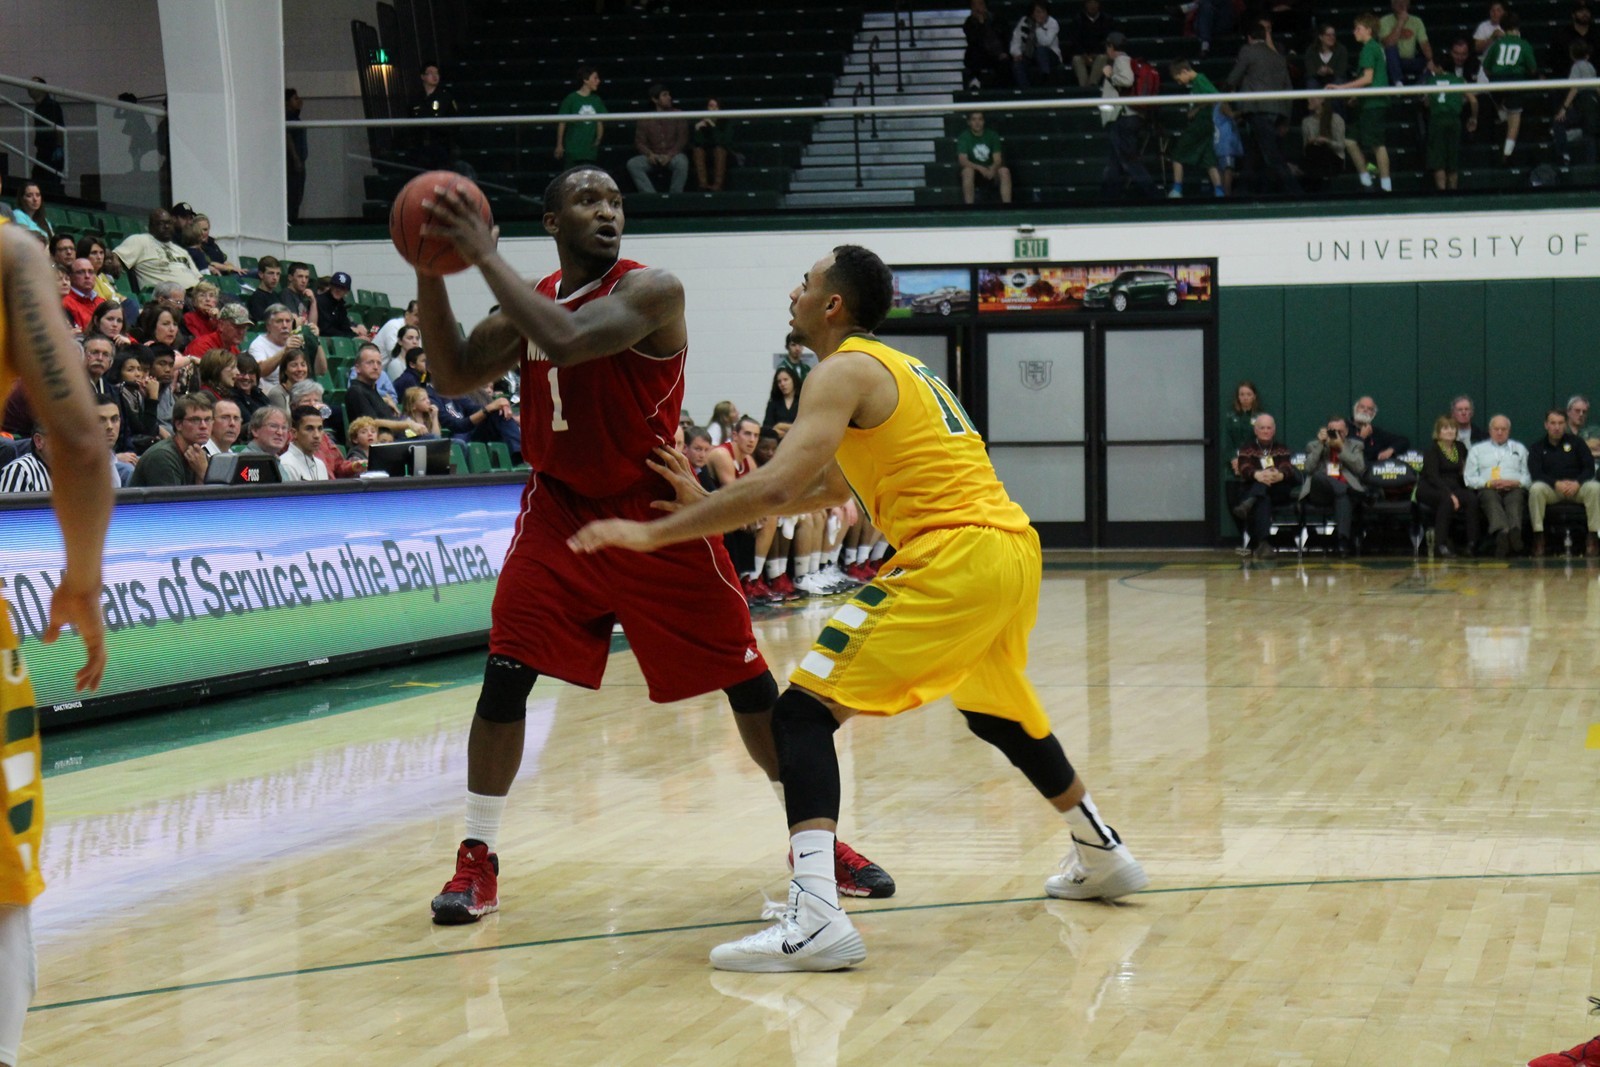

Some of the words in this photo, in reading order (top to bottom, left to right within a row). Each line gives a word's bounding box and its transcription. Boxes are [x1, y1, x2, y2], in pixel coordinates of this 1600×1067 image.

[1496, 43, 1521, 66] 10
[1019, 239, 1045, 258] EXIT
[1307, 235, 1524, 262] UNIVERSITY
[1547, 233, 1589, 256] OF
[547, 366, 569, 432] 1
[158, 556, 197, 624] of
[190, 550, 312, 619] Service
[306, 550, 344, 602] to
[338, 542, 391, 599] the
[381, 539, 441, 603] Bay
[435, 535, 499, 586] Area.
